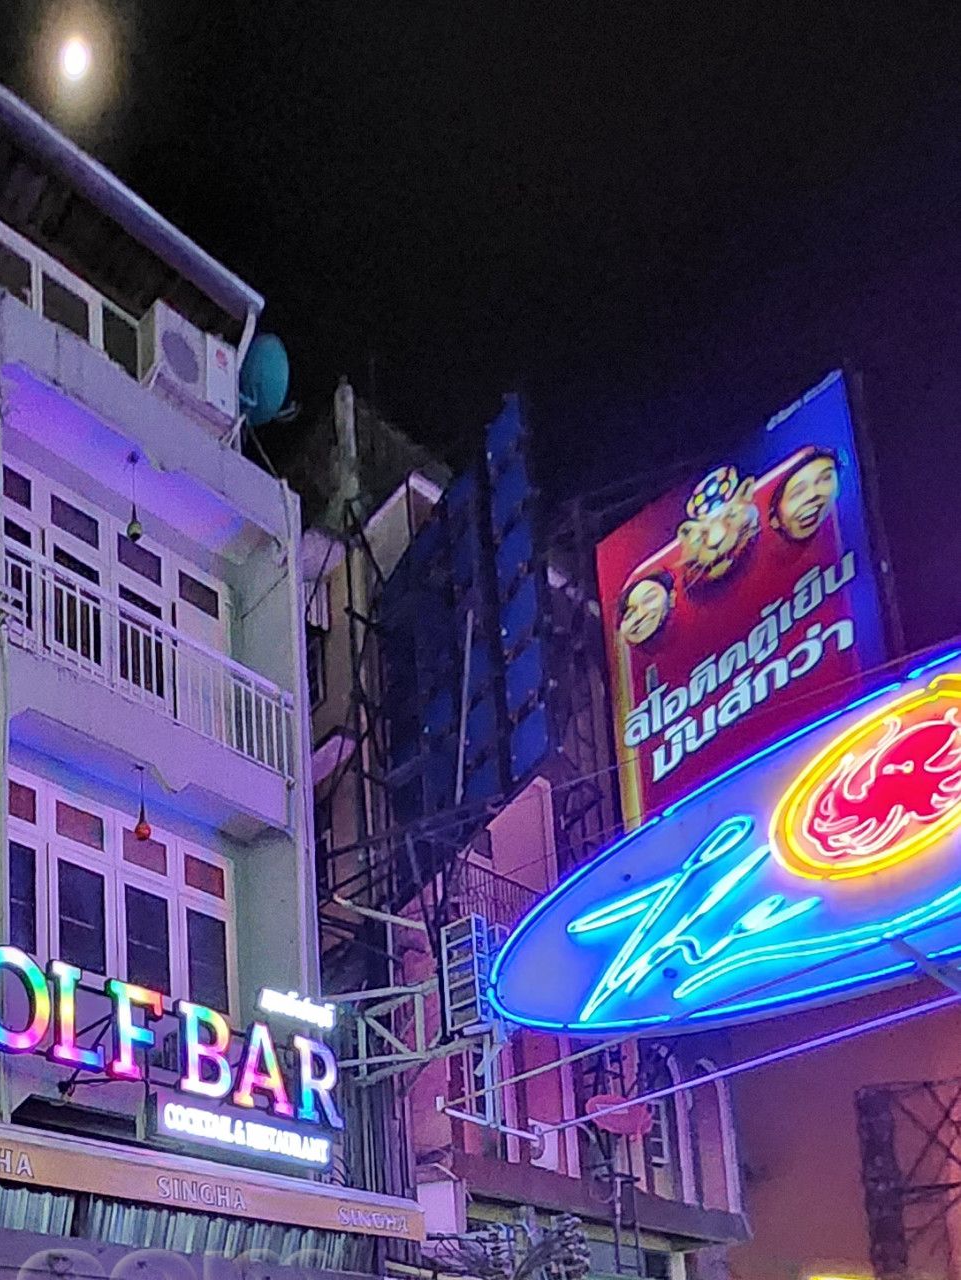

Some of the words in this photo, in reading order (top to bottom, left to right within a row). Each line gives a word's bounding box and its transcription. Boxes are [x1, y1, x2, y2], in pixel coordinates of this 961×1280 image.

[176, 999, 345, 1129] BAR
[156, 1175, 248, 1212] SINGHA
[338, 1206, 410, 1234] SINGHA
